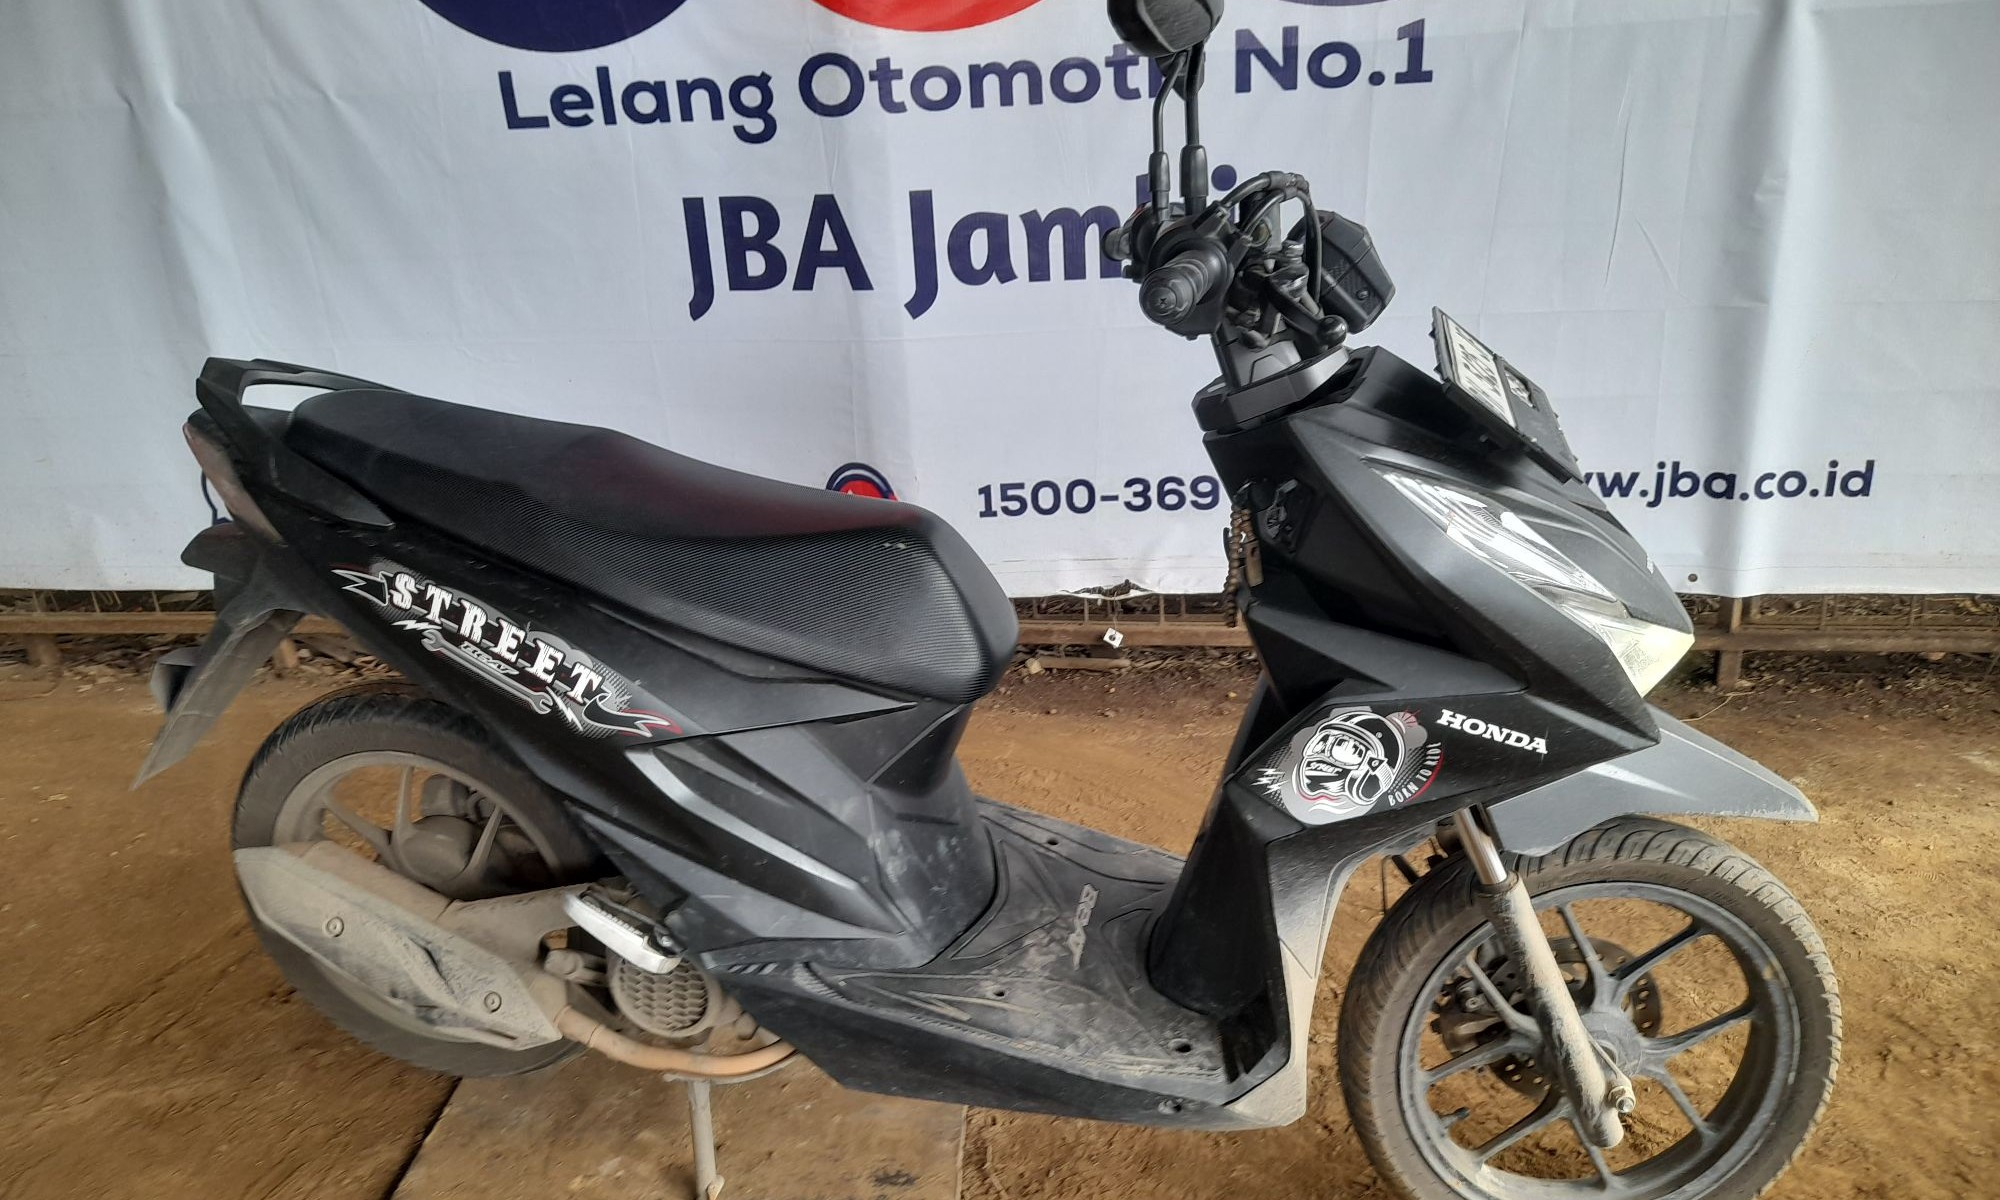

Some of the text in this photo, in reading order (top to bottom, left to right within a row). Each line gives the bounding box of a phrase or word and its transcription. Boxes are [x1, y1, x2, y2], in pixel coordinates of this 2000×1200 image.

[498, 18, 1433, 144] Lelang Otomoti No.1
[682, 163, 1237, 322] JBA Jam
[977, 475, 1221, 518] 1500-369
[392, 573, 603, 704] STREET
[1436, 709, 1549, 754] HONDA
[1388, 781, 1419, 806] BORN
[1415, 768, 1433, 781] TO
